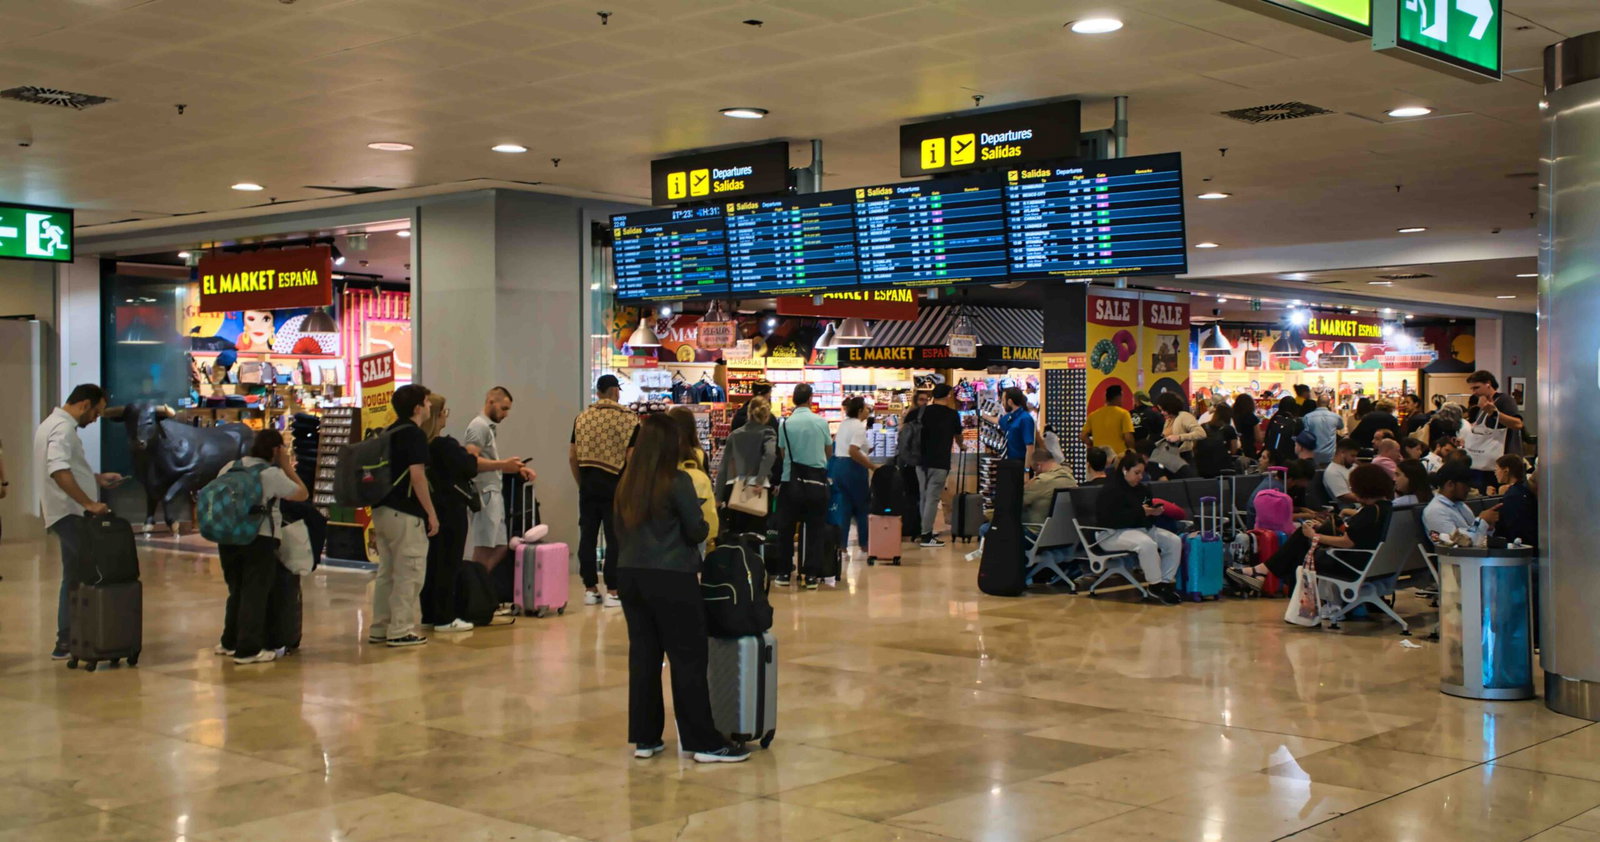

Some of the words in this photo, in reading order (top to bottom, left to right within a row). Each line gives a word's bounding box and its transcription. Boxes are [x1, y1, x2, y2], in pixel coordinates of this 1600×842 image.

[981, 129, 1032, 145] Departures
[981, 145, 1021, 160] Salidas
[712, 166, 752, 179] Departures
[1021, 169, 1051, 178] Salidas
[713, 179, 744, 192] Salidas
[867, 187, 893, 196] Salidas
[736, 202, 759, 211] Salidas
[622, 227, 642, 235] Salidas
[203, 275, 217, 295] EL
[219, 269, 275, 293] MARKET
[278, 268, 318, 288] ESPAÑA
[1096, 299, 1130, 321] SALE
[1151, 304, 1182, 325] SALE
[1308, 318, 1319, 334] EL
[1320, 319, 1357, 336] MARKET
[1358, 324, 1382, 337] ESPAÑA
[849, 348, 861, 360] EL
[864, 347, 915, 360] MARKET
[1002, 346, 1011, 359] EL
[362, 356, 392, 383] SALE
